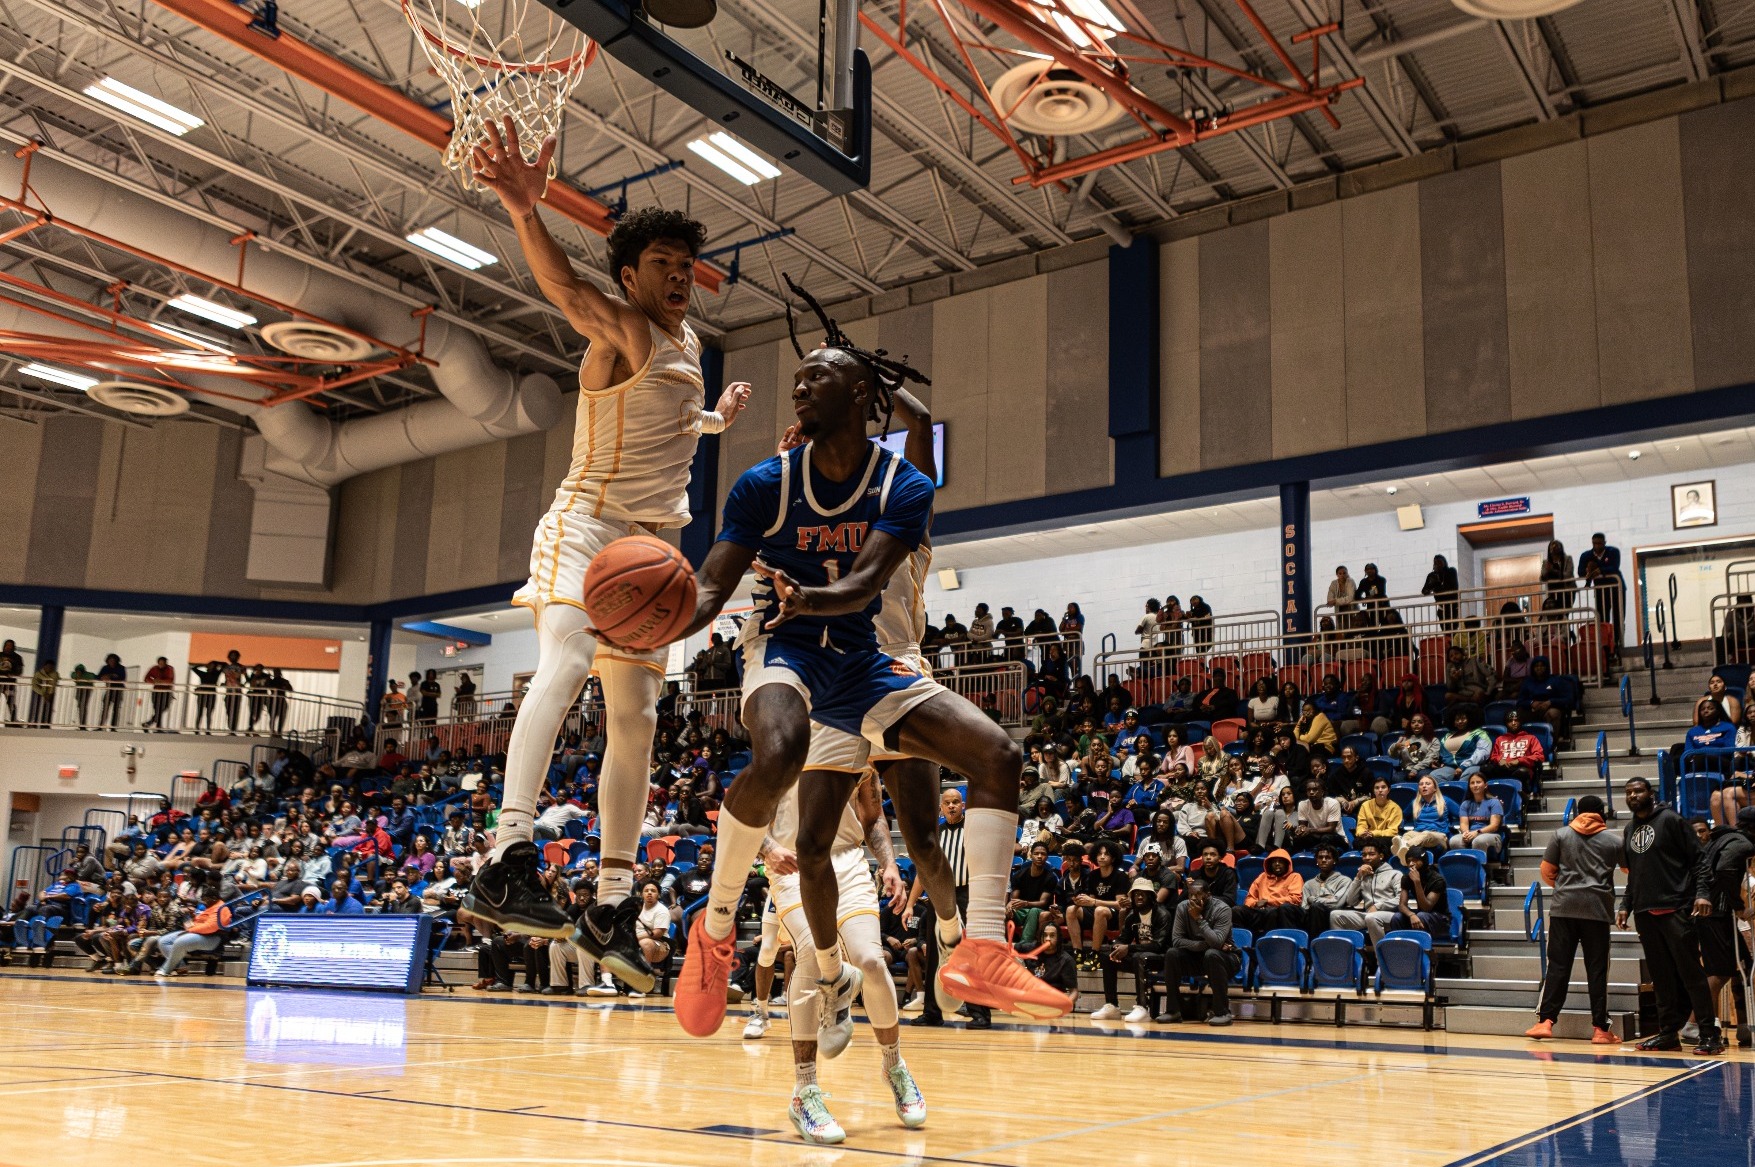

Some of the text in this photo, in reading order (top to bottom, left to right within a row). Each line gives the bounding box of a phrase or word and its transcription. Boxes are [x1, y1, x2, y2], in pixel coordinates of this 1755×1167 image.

[796, 521, 868, 553] FMU
[822, 559, 840, 585] 1
[1285, 524, 1298, 632] SOCIAL
